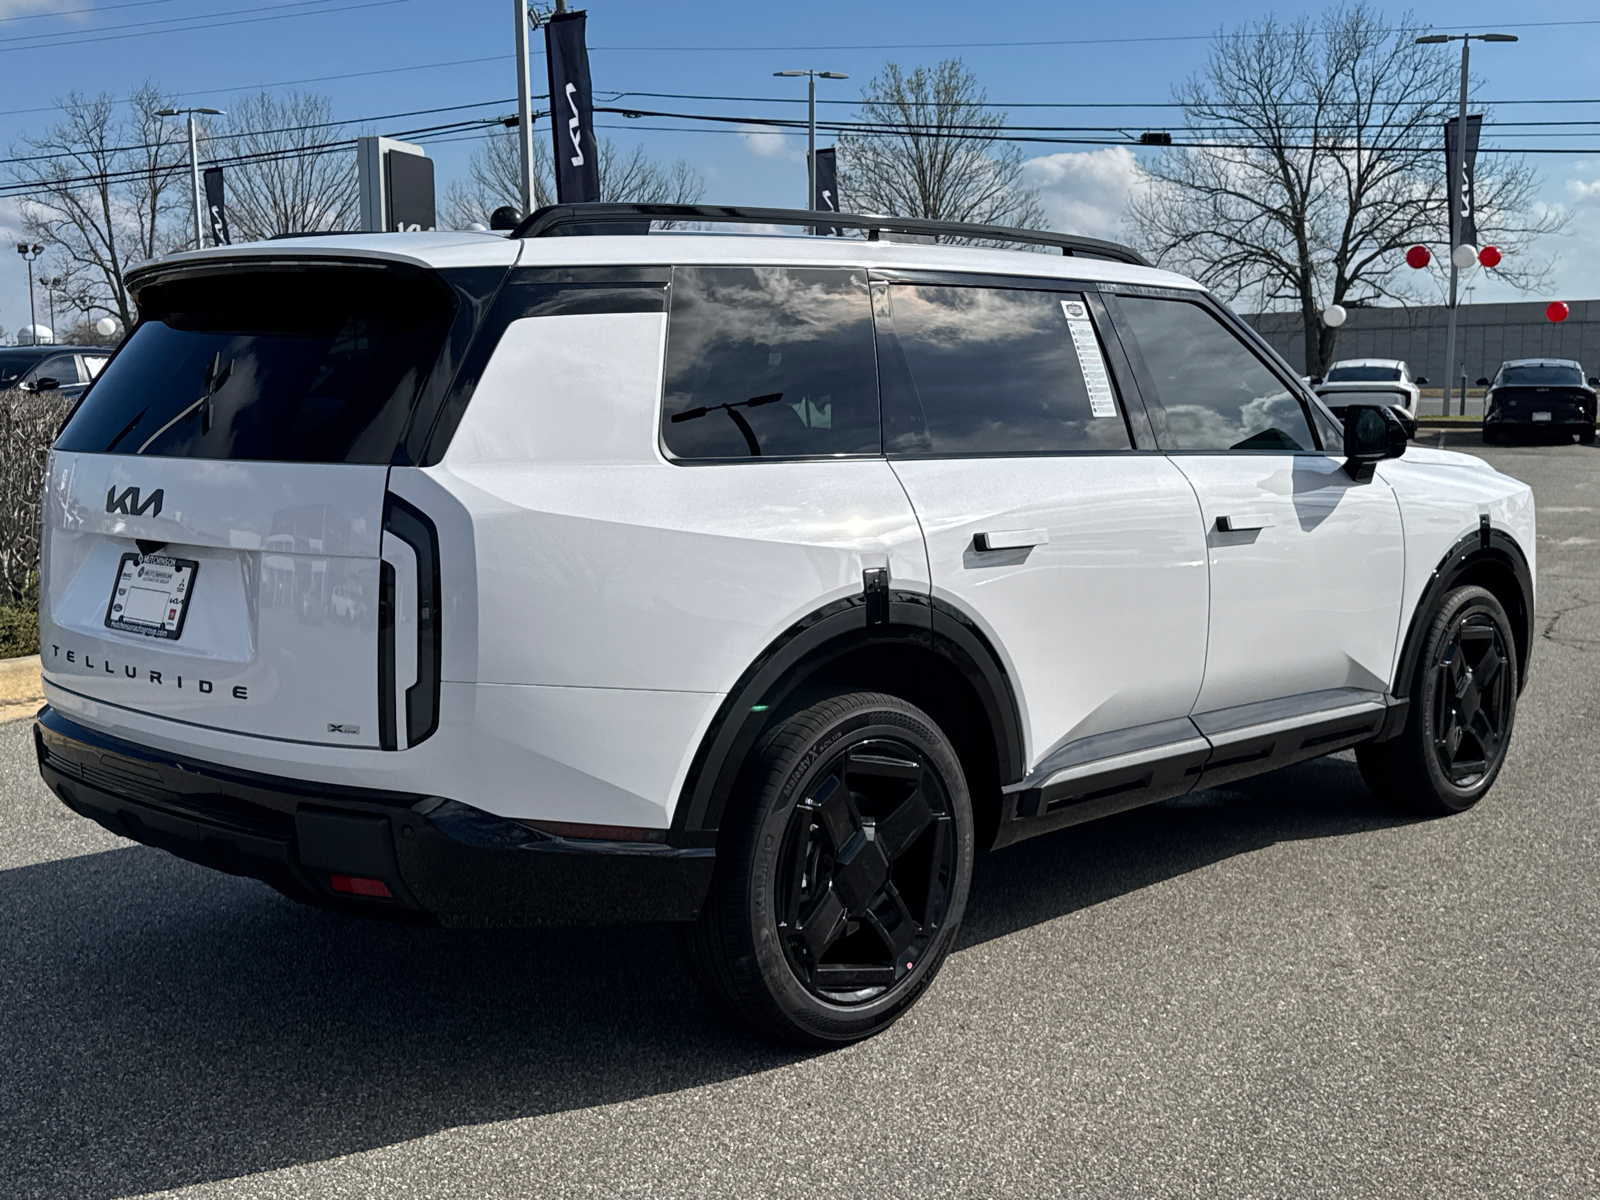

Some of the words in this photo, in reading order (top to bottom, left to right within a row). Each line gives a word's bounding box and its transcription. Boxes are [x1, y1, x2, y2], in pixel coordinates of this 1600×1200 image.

[565, 82, 584, 167] KIA
[106, 485, 164, 518] KIA
[144, 554, 176, 567] HUTCHINSON
[52, 645, 248, 699] TELLURIDE
[818, 731, 844, 752] SOLUS
